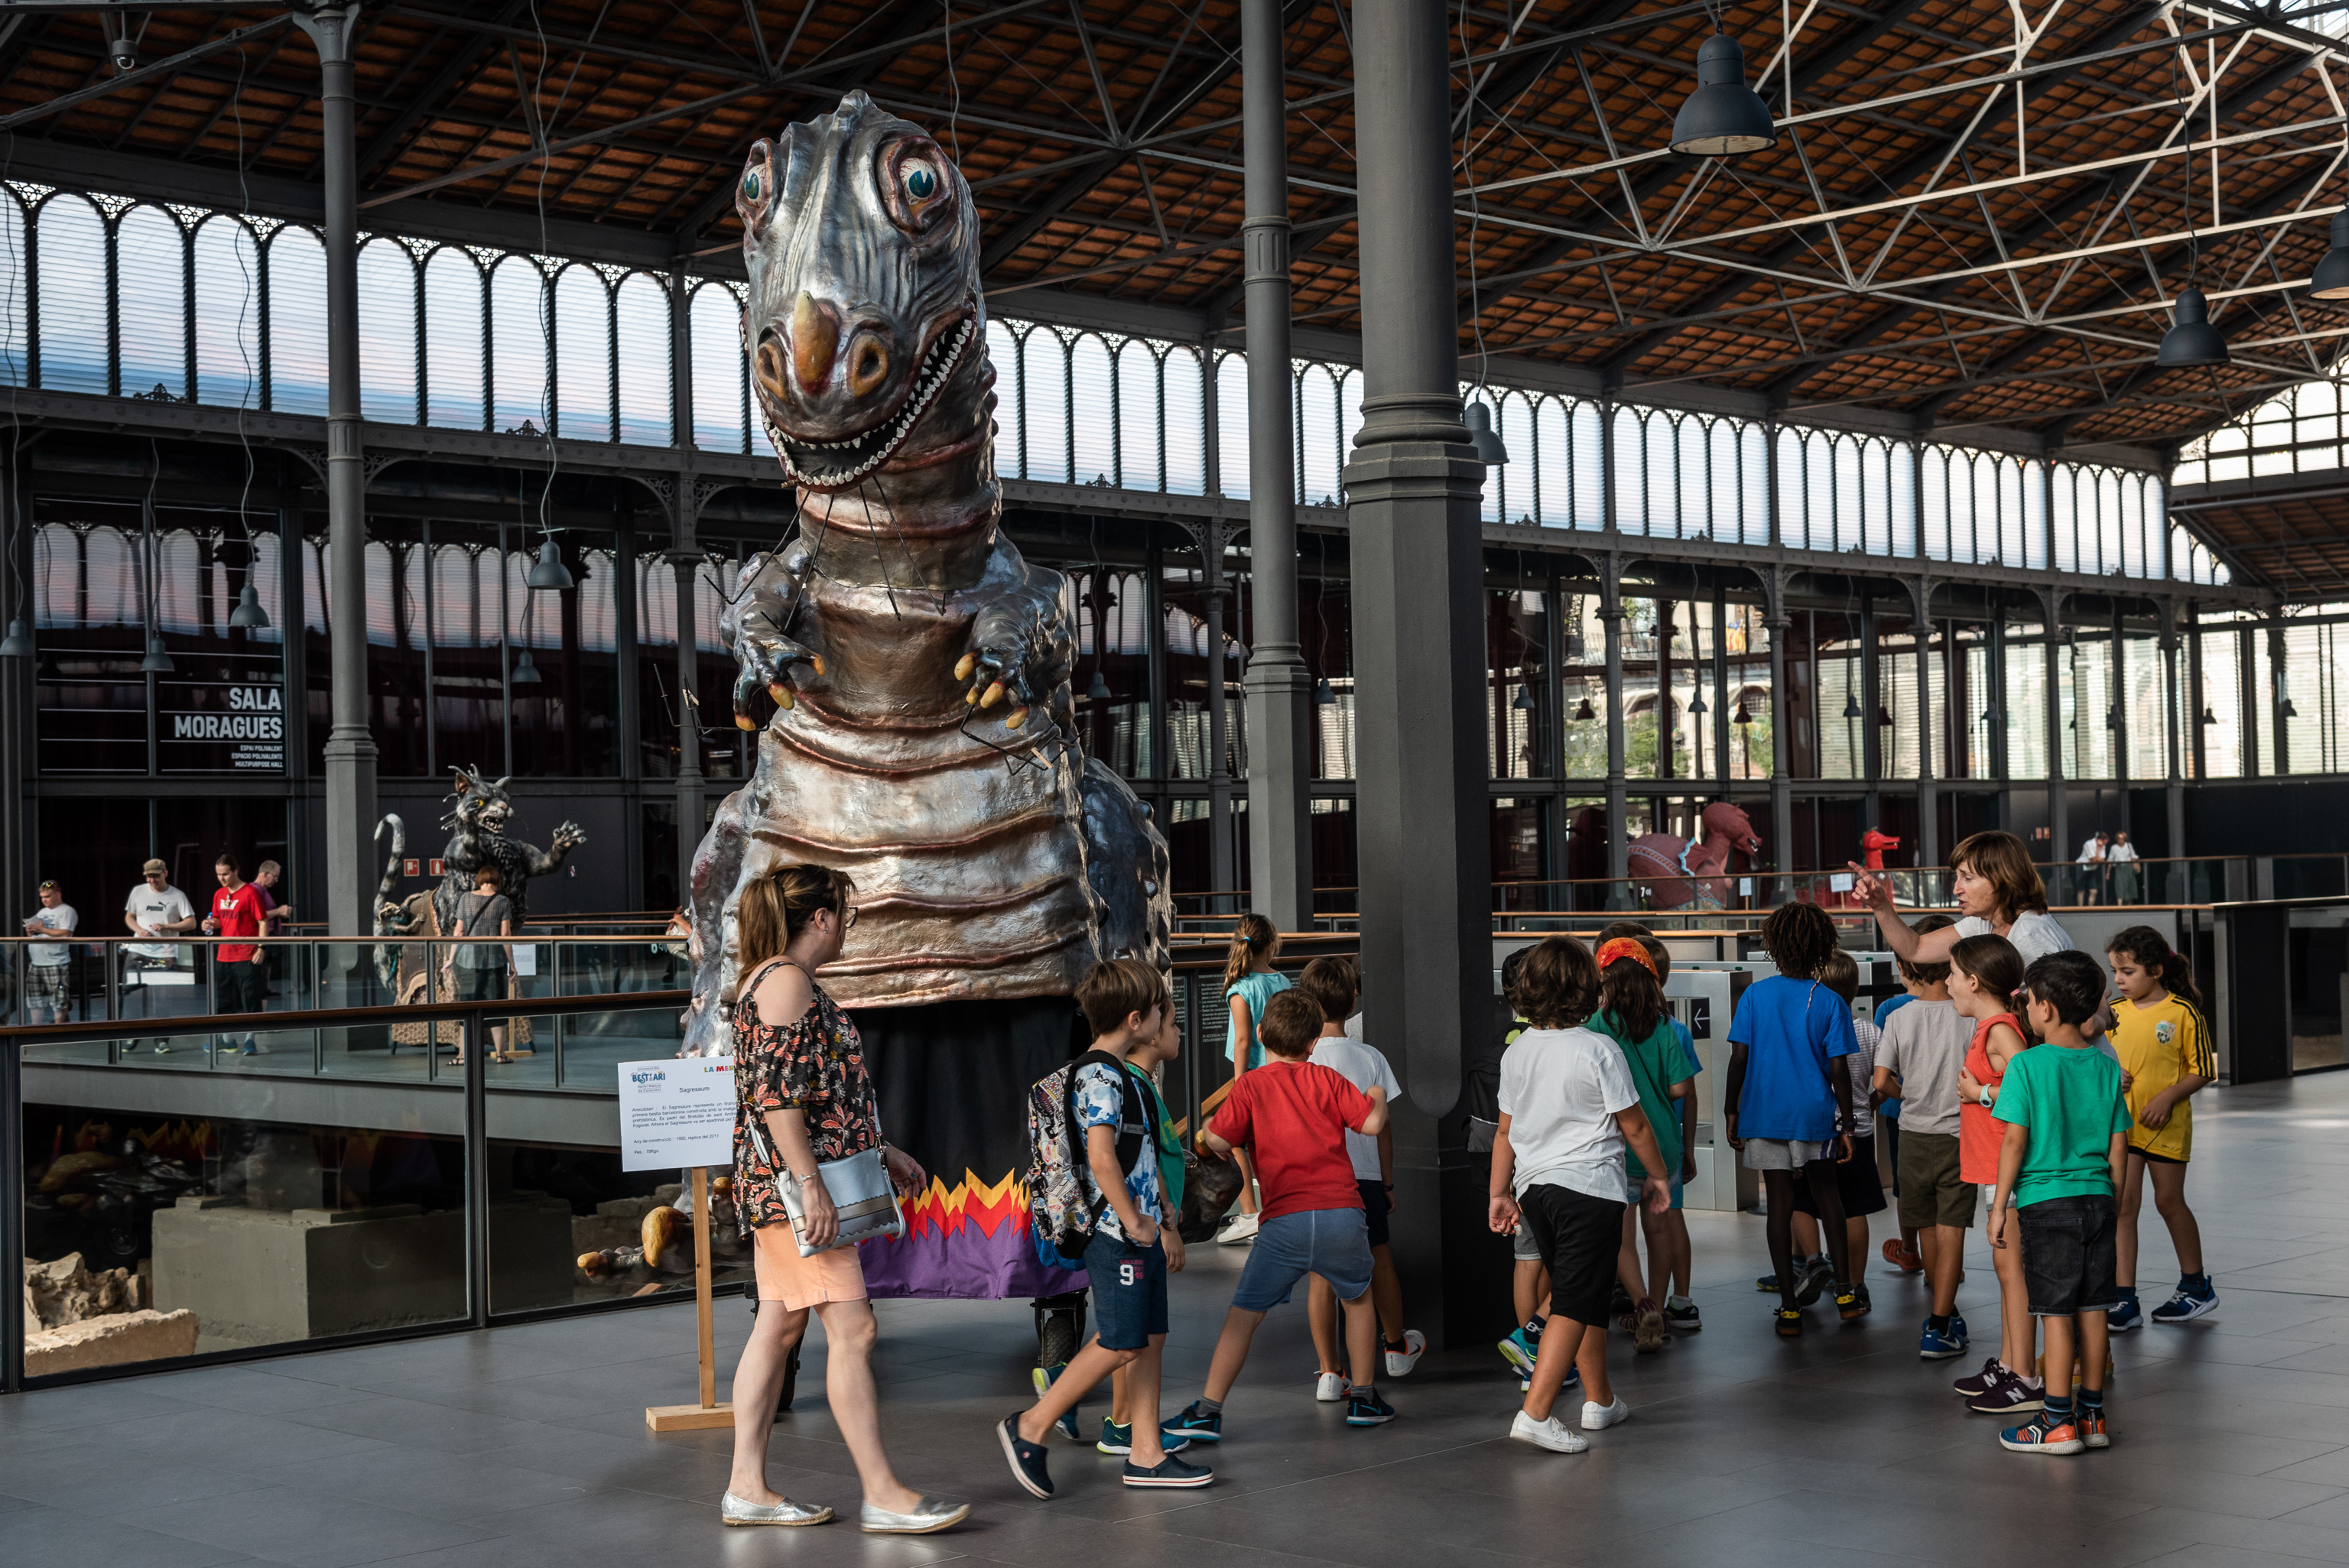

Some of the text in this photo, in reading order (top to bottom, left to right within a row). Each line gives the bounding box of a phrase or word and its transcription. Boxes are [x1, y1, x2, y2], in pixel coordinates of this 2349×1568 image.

[229, 687, 282, 710] SALA
[174, 716, 283, 739] MORAGUES
[1119, 1264, 1134, 1286] 9
[1983, 1372, 1997, 1388] N
[2006, 1387, 2026, 1403] N
